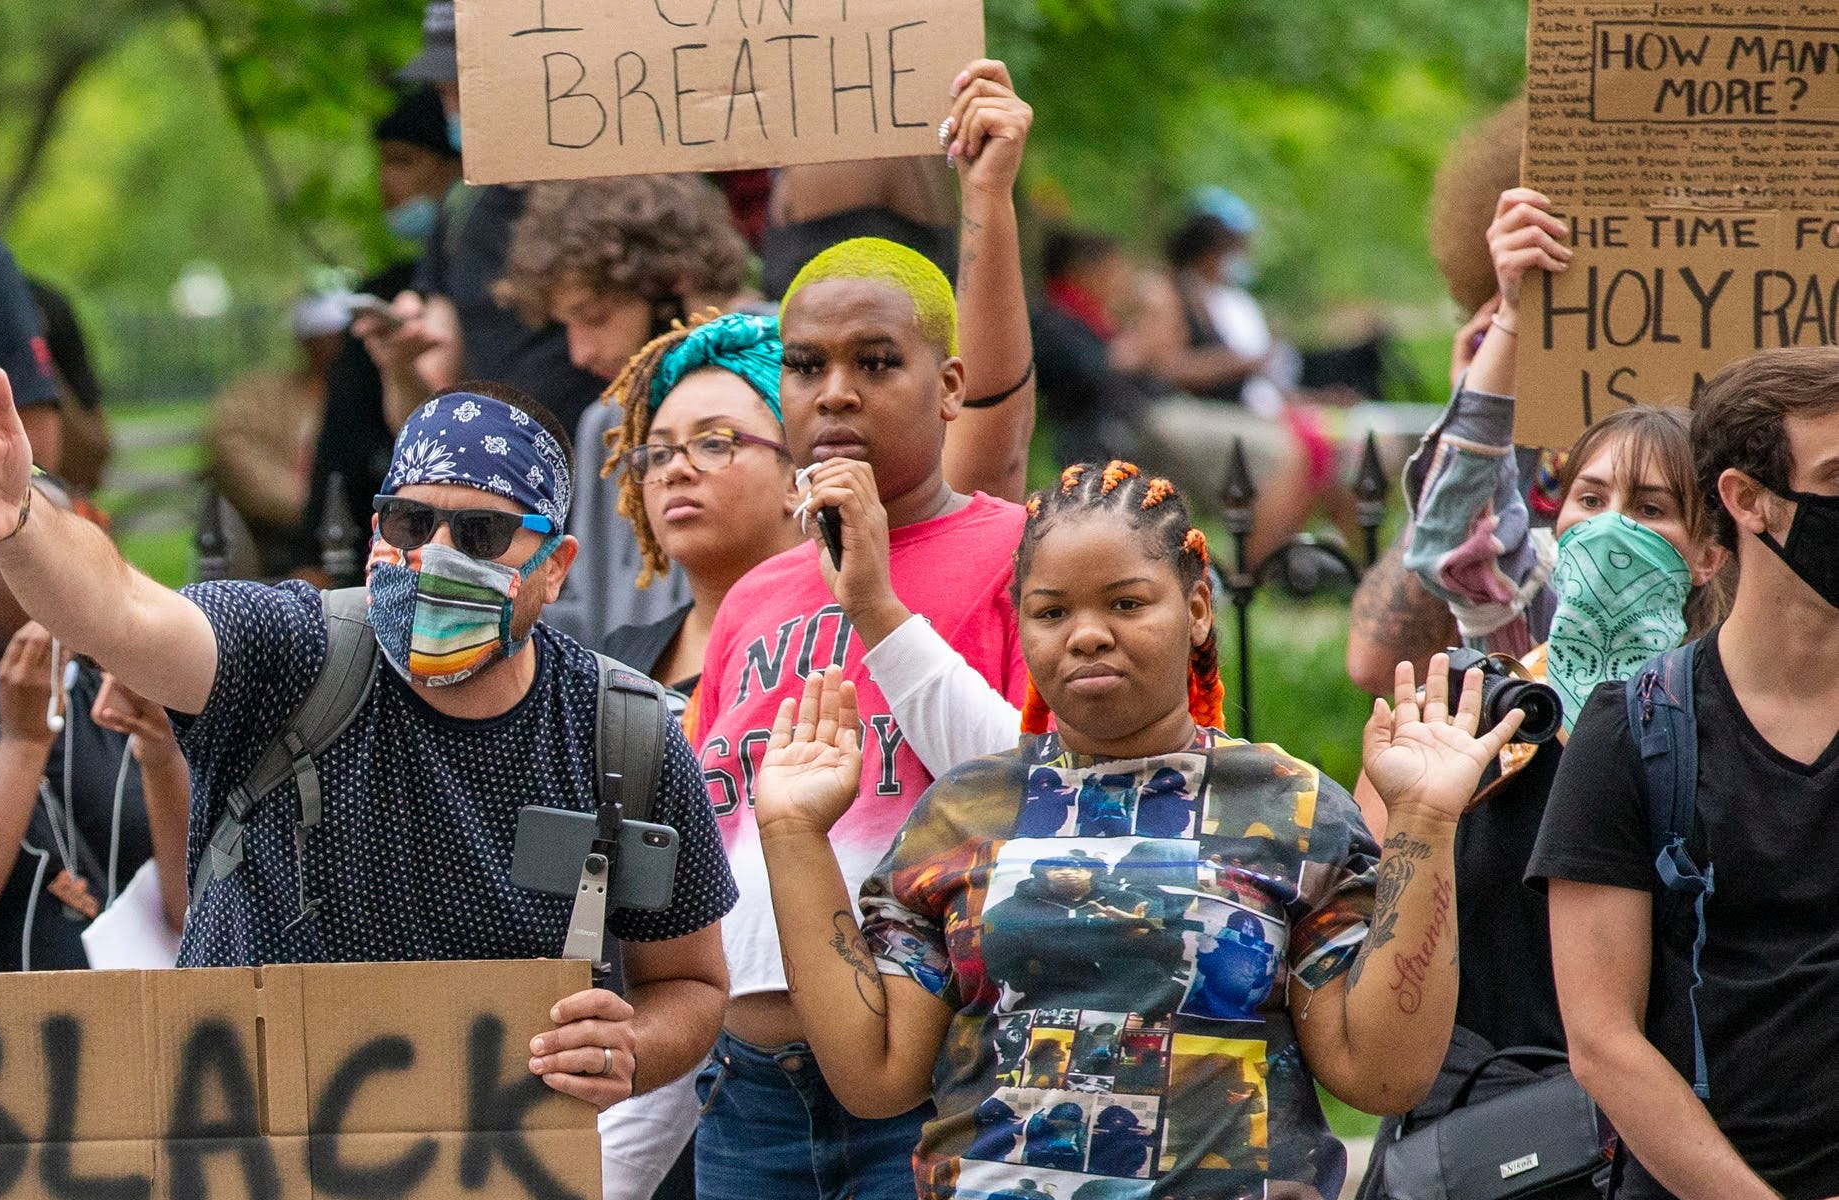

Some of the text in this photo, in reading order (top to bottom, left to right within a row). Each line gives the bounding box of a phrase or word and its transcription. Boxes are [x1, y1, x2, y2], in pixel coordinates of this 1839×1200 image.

[543, 20, 929, 149] BREATHE
[1601, 30, 1710, 72] HOW
[1654, 77, 1808, 116] MORE?
[1554, 212, 1629, 249] HE
[1645, 215, 1761, 249] TIME
[1543, 264, 1735, 350] HOLY
[1581, 366, 1639, 427] IS
[730, 603, 931, 711] NO
[700, 713, 906, 817] SOY
[1389, 872, 1452, 1015] Strength
[1507, 1159, 1533, 1173] Nikon
